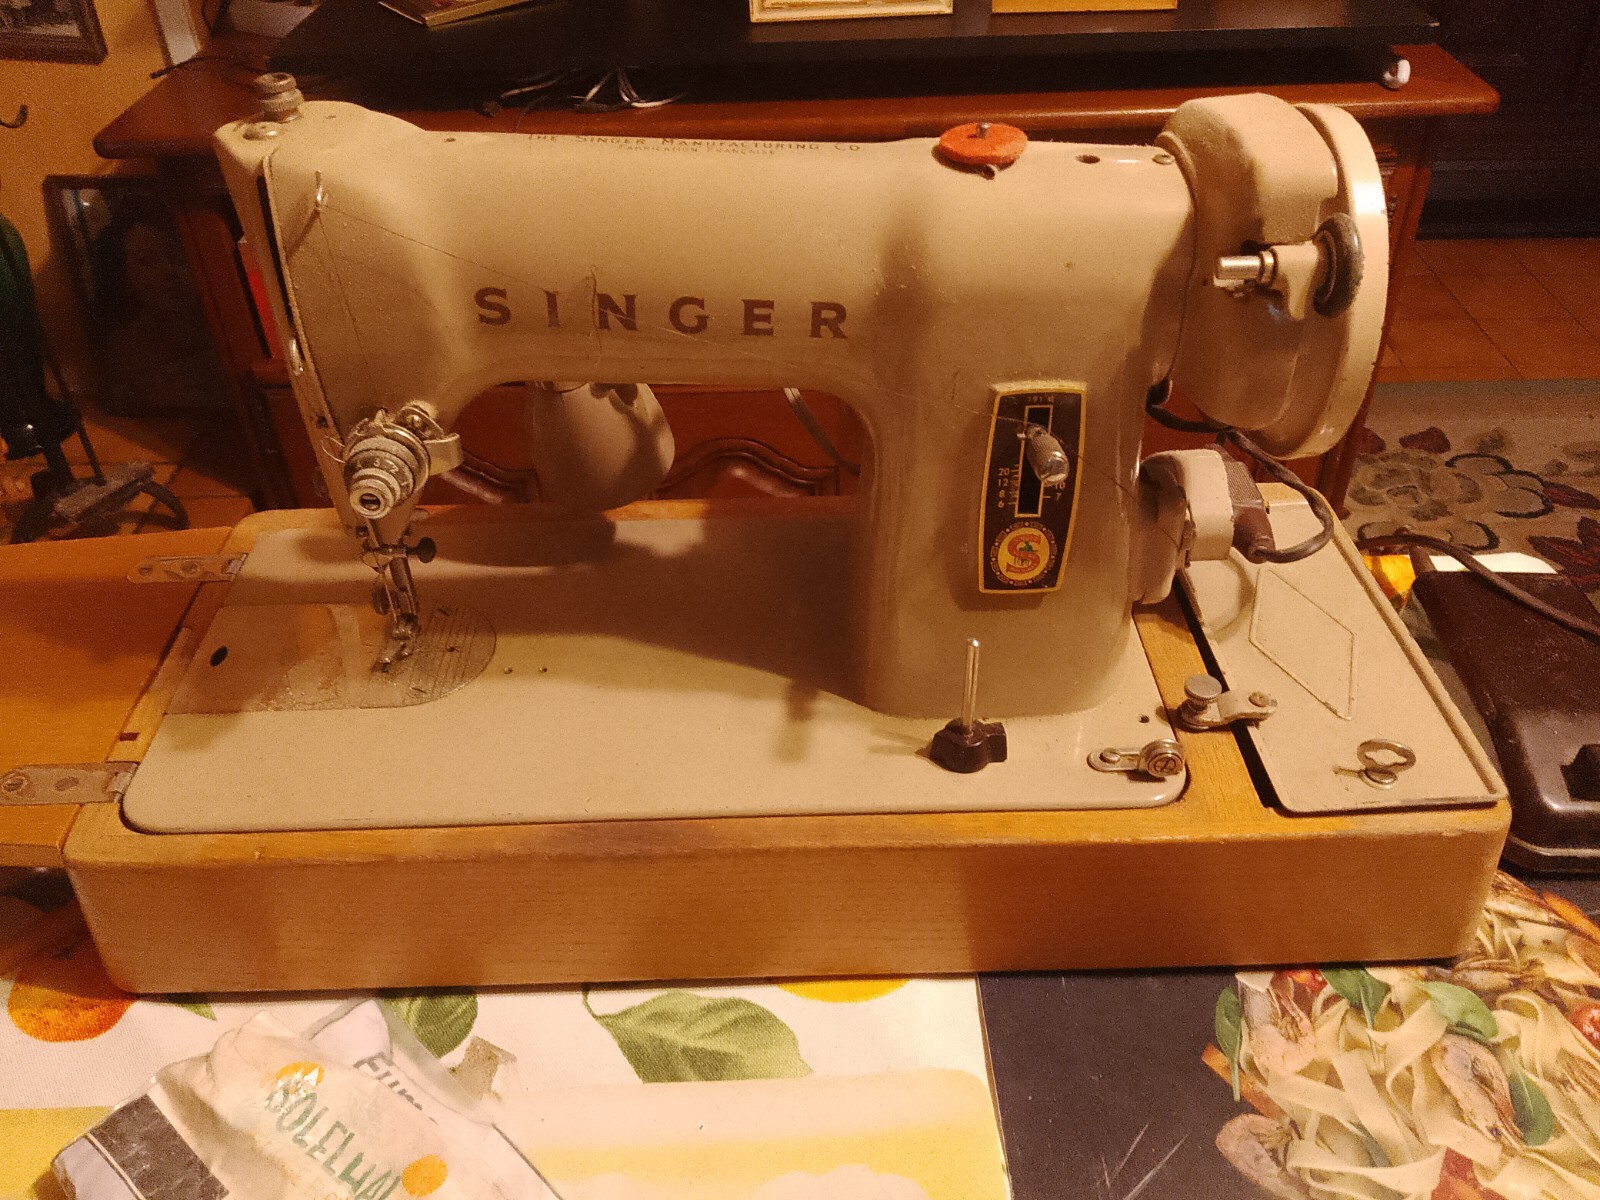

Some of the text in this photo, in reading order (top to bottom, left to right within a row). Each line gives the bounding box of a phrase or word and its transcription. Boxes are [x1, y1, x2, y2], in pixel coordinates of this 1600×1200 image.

[576, 135, 646, 145] SINGER
[662, 137, 819, 150] MANUFACTURING
[473, 287, 848, 339] SINGER
[998, 467, 1010, 476] 20
[998, 478, 1009, 487] 12
